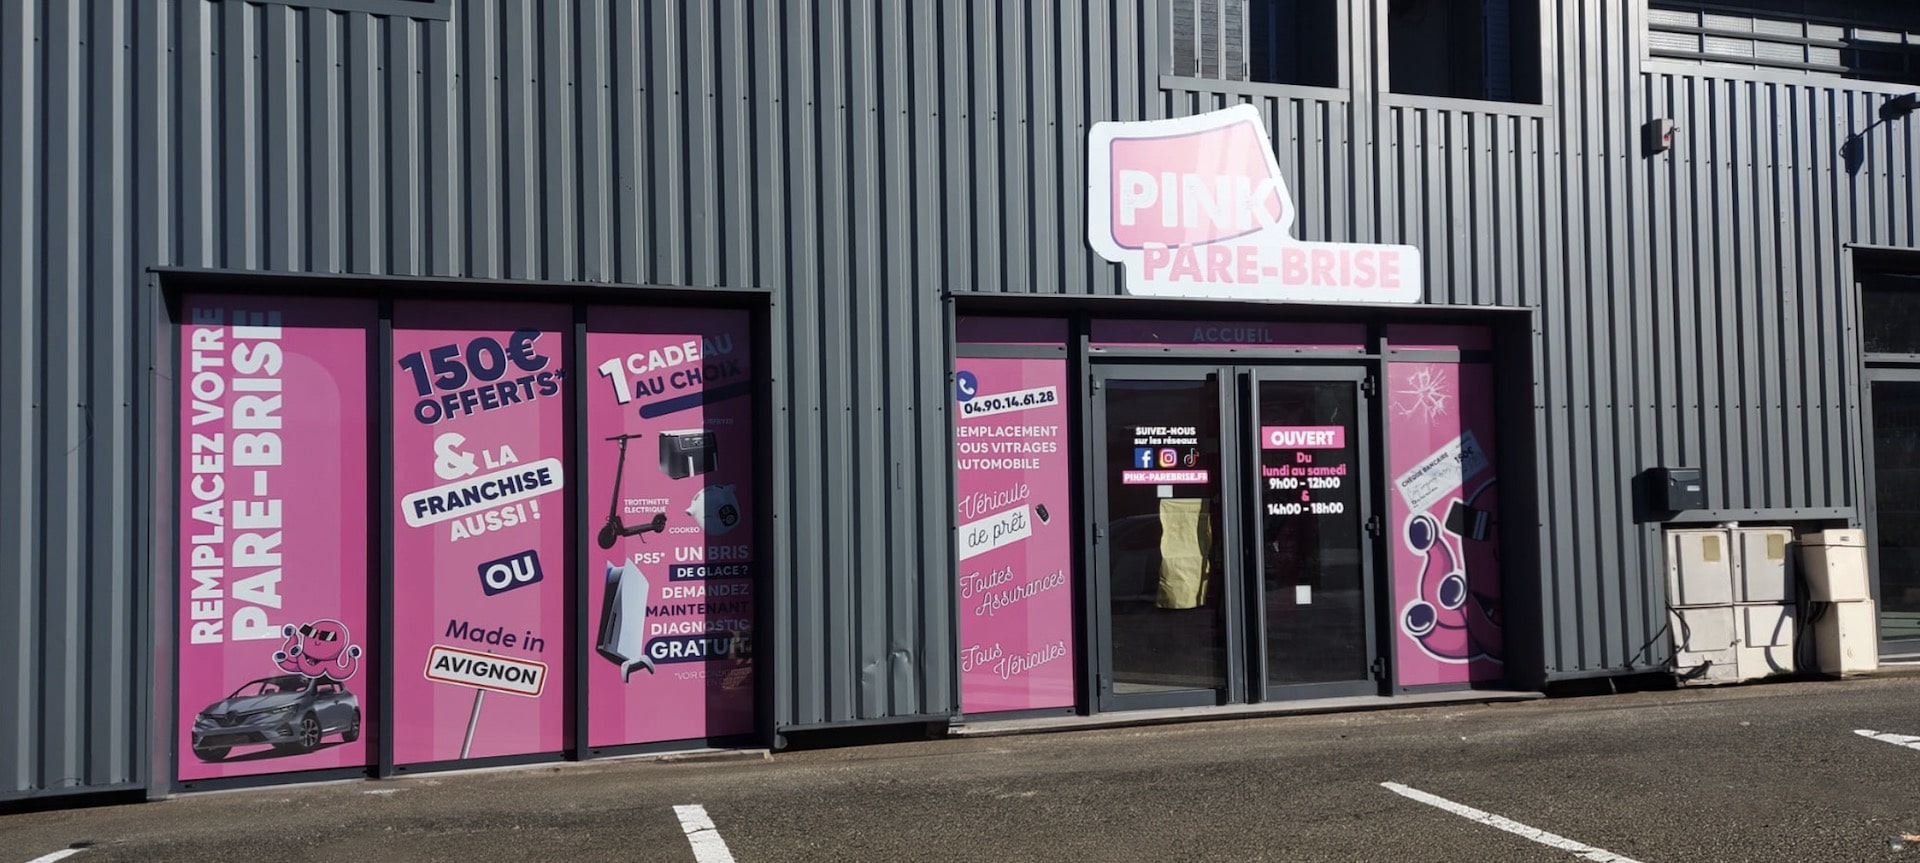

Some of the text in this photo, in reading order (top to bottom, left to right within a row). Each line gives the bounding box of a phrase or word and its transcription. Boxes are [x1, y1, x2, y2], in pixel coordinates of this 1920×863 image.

[1119, 169, 1278, 230] PINK
[1143, 243, 1401, 289] PARE-BRISE
[1193, 327, 1273, 343] ACCUEIL
[398, 328, 550, 397] 150€
[598, 333, 733, 405] 1 CADEAU
[635, 359, 741, 399] AU CHOIX
[963, 390, 1055, 415] 04.90.14.61.28
[1135, 426, 1196, 436] SUIVEZ-NOUS
[1149, 435, 1162, 445] les
[1163, 436, 1198, 445] réseaux
[1271, 430, 1336, 446] OUVERT
[434, 432, 519, 480] & LA
[957, 441, 1057, 454] OUS VITRAGES
[1296, 452, 1312, 463] Du
[191, 307, 224, 644] REMPLACEZ VOTRE
[232, 310, 283, 641] PARE-BRISE
[1262, 463, 1346, 477] lundi au samedi
[1422, 452, 1449, 474] BANCAIRE
[1123, 472, 1208, 482] PINK-PAREBRISE.FR
[1269, 477, 1298, 490] 9h00
[1307, 476, 1341, 489] 12h00
[413, 467, 553, 519] FRANCHISE
[958, 482, 1030, 519] Véhicule
[1267, 502, 1301, 515] 14h00
[1310, 502, 1344, 514] 18h00
[450, 503, 527, 542] AUSSI
[669, 526, 700, 534] COOKEO
[968, 511, 1026, 548] de prêt
[675, 545, 749, 562] UN BRIS
[485, 555, 535, 590] OU
[677, 567, 694, 578] DE
[697, 566, 739, 577] GLACE
[960, 565, 1014, 599] Toutes
[662, 584, 749, 599] DEMANDEZ
[975, 569, 1066, 617] Assurances
[645, 601, 749, 617] MAINTENANT
[445, 619, 545, 653] Made in
[651, 619, 750, 635] DIAGNOSTIC
[650, 637, 749, 660] GRATUIT
[961, 641, 1067, 680] Tous Véhicules
[434, 655, 537, 685] AVIGNON
